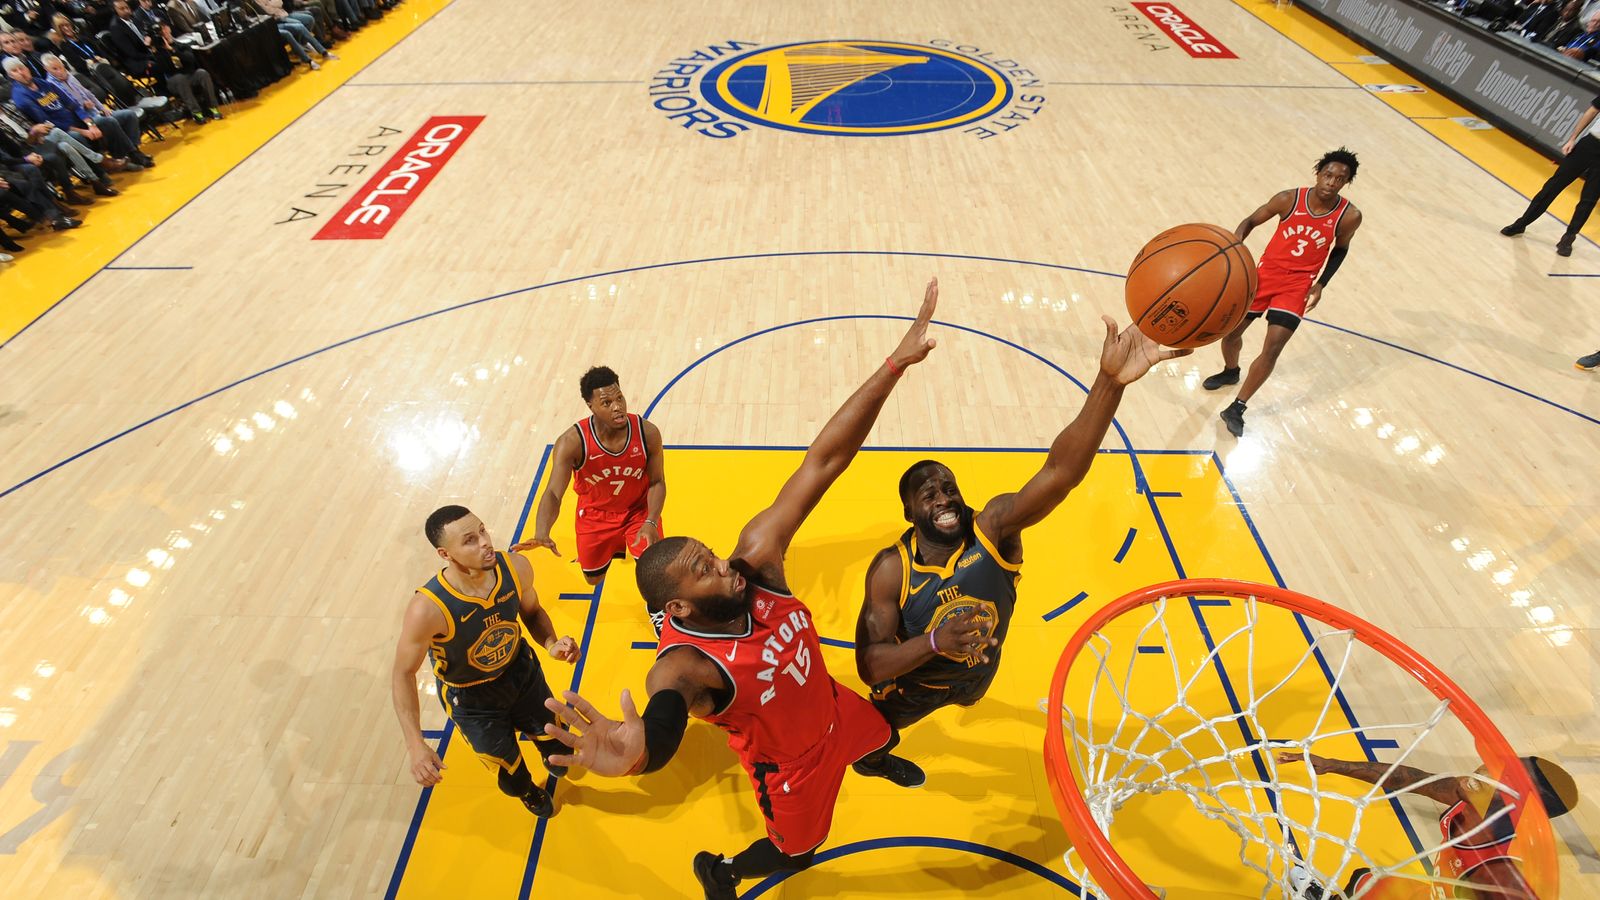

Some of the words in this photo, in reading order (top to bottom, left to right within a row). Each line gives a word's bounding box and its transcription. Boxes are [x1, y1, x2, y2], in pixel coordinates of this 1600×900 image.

[1105, 5, 1170, 52] ARENA
[1146, 5, 1222, 54] ORACLE
[1376, 7, 1404, 47] Play
[1393, 16, 1423, 53] Now
[930, 39, 1044, 88] GOLDEN
[649, 40, 760, 139] WARRIORS
[1474, 59, 1551, 120] Download
[1531, 89, 1560, 126] &
[963, 94, 1045, 140] STATE
[274, 125, 402, 225] ARENA
[344, 123, 465, 226] ORACLE
[1282, 225, 1327, 249] APTOR
[1290, 239, 1308, 257] 3
[585, 466, 644, 486] APTOR
[609, 480, 625, 495] 7
[937, 585, 962, 604] THE
[483, 612, 502, 628] THE
[487, 646, 507, 665] 30
[756, 610, 809, 706] RAPTORS
[781, 639, 812, 687] 15
[966, 654, 981, 668] BA
